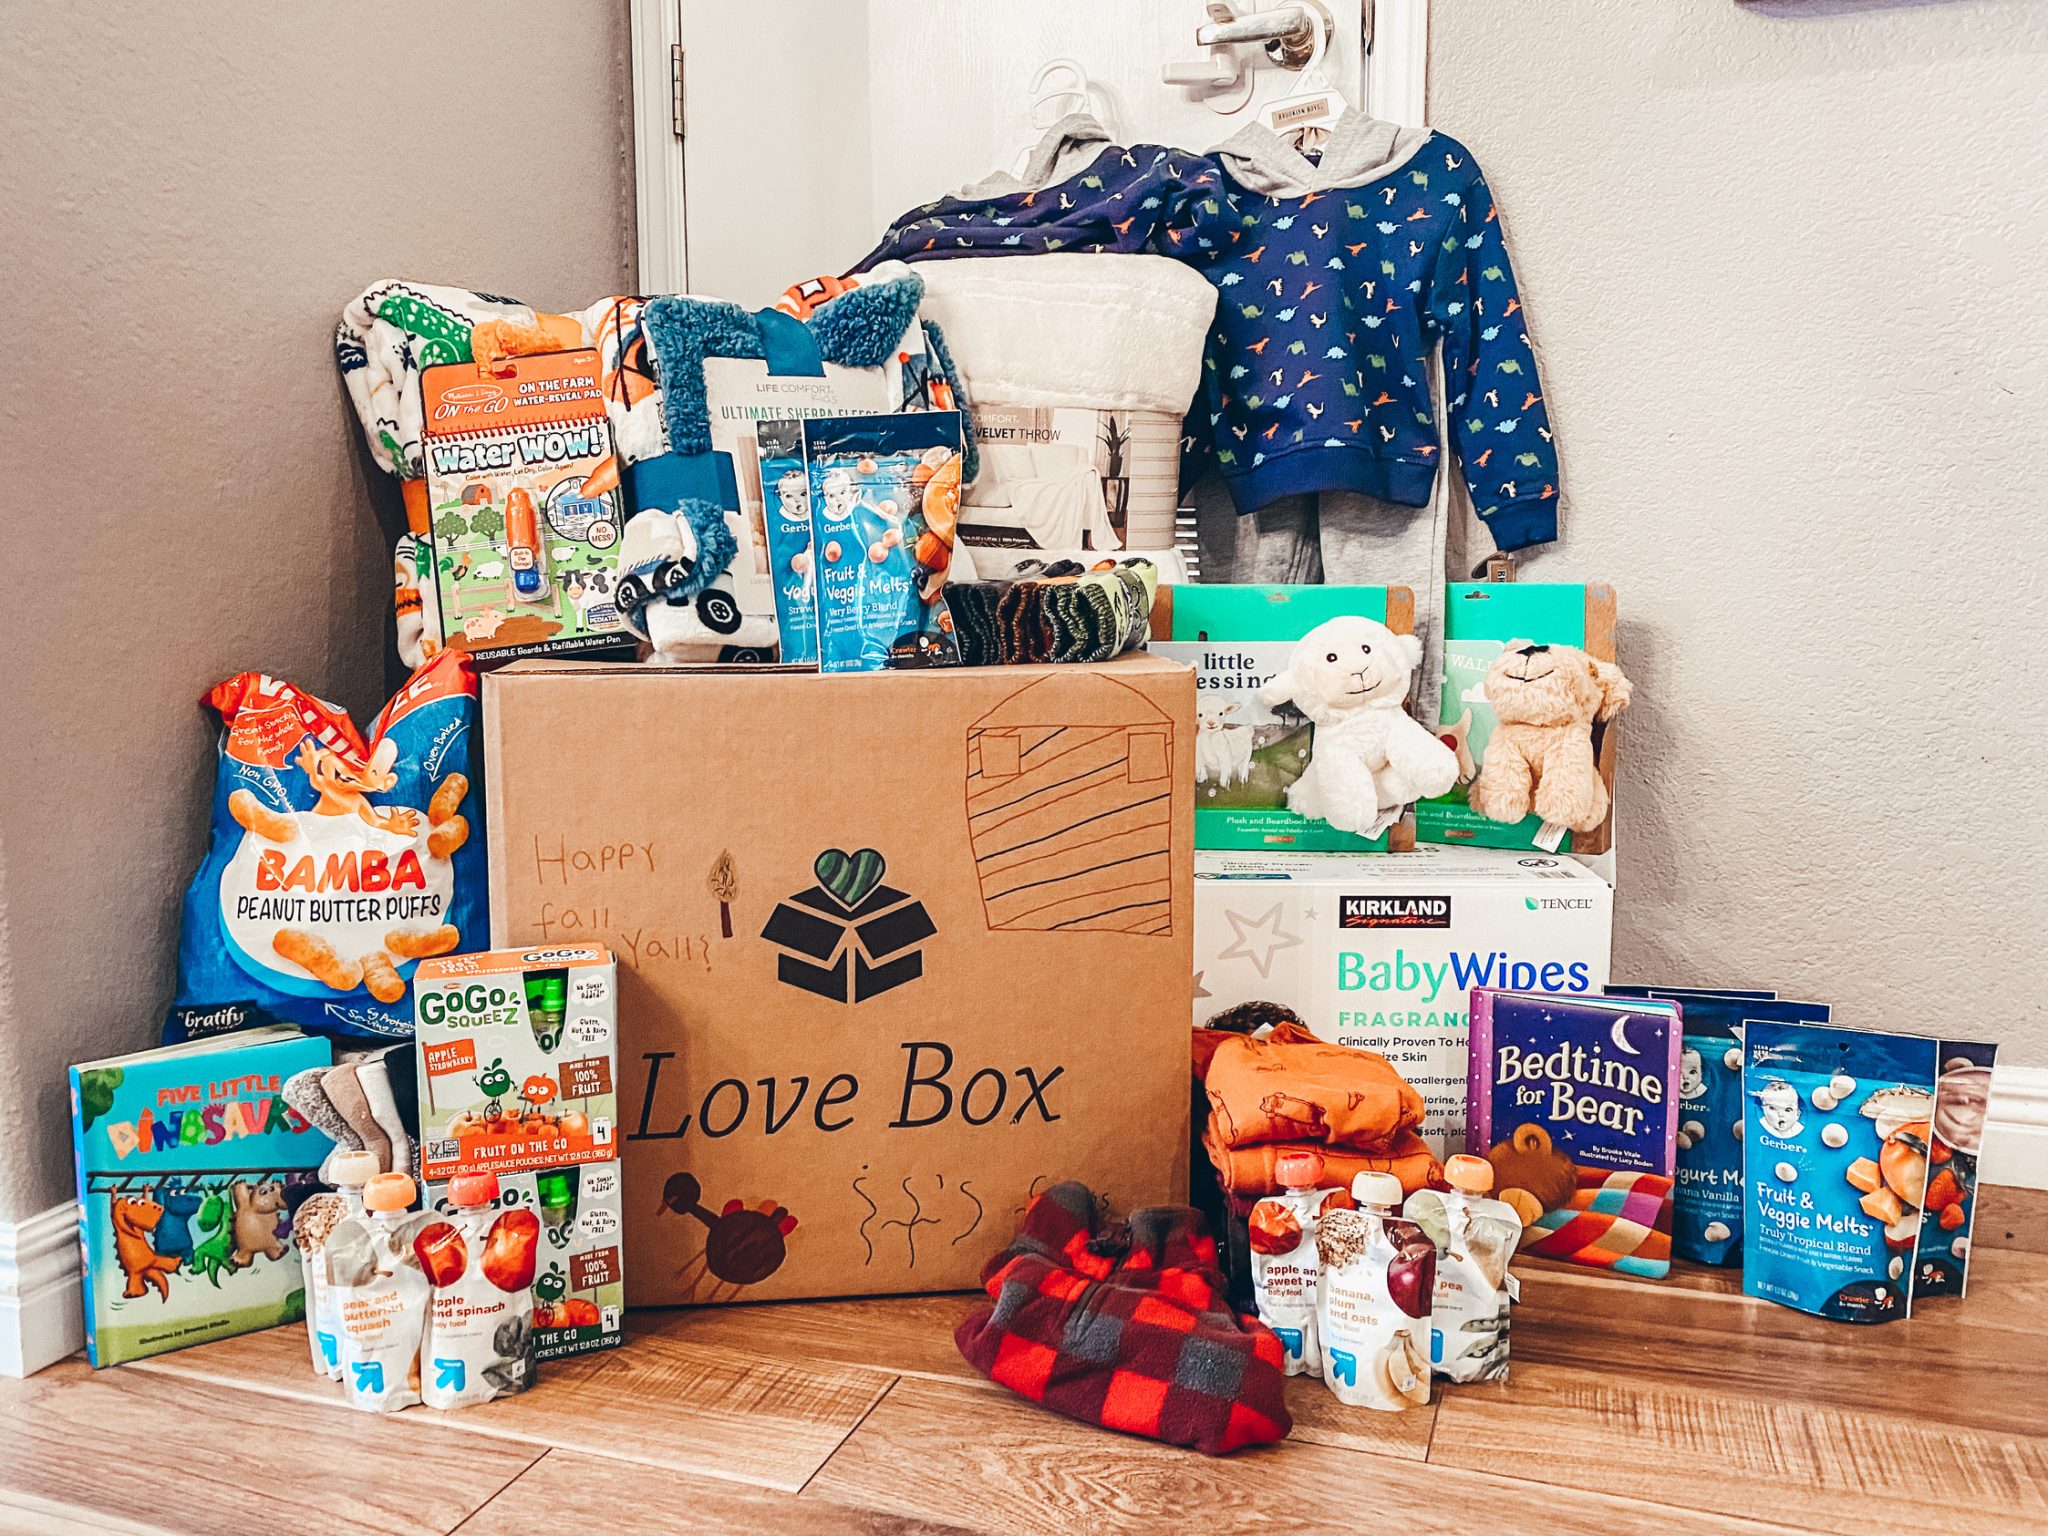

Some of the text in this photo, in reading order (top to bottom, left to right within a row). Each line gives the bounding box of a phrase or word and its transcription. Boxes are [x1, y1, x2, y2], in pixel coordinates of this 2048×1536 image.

[519, 377, 594, 393] ON THE FARM
[756, 384, 779, 393] LIFE
[513, 388, 602, 407] WATER-REVEAL PAD
[434, 397, 509, 420] ON GO
[721, 406, 783, 420] ULTIMATE
[976, 427, 1061, 441] VELVET THROW
[434, 426, 600, 473] Water WOW!
[596, 526, 607, 534] NO
[591, 534, 614, 542] MESS!
[825, 565, 855, 584] Fruit
[827, 584, 866, 604] Veggie
[872, 601, 898, 611] Blend
[475, 635, 621, 661] REUSABLE Boards & Refillable Water Pen
[1204, 653, 1254, 670] little
[231, 726, 264, 737] Great
[238, 722, 295, 746] for the whole
[257, 741, 285, 756] Family
[424, 717, 463, 772] Oven Baked
[239, 765, 288, 797] Non GMO
[1226, 816, 1264, 825] Plush and
[256, 849, 428, 893] BAMBA
[237, 894, 441, 923] PEANUT BUTTER PUFFS
[1346, 900, 1447, 915] KIRKLAND
[532, 903, 609, 939] fall
[1346, 914, 1447, 928] Signature
[586, 982, 603, 991] Sugar
[419, 984, 506, 1025] GoGo
[185, 1006, 245, 1028] Gratify
[447, 1007, 518, 1029] SQUEEZ
[593, 1026, 608, 1036] Dairy
[1338, 1036, 1453, 1048] Clinically Proven To
[428, 1048, 457, 1063] APPLE
[1402, 1053, 1428, 1062] Skin
[430, 1056, 474, 1071] STRAWBERRY
[574, 1069, 598, 1082] 100%
[1496, 1041, 1662, 1104] Bedtime
[157, 1074, 281, 1107] FIVE LITTLE
[571, 1081, 601, 1096] FRUIT
[627, 1041, 1064, 1141] Love Box
[1515, 1081, 1645, 1137] for Bear
[107, 1093, 313, 1160] DINOSAURS
[597, 1126, 605, 1140] 4
[473, 1146, 506, 1159] FRUIT
[510, 1143, 525, 1155] ON
[528, 1141, 549, 1153] THE
[553, 1138, 568, 1150] GO
[1592, 1145, 1641, 1158] By Brooke Vitale
[476, 1159, 515, 1172] APPLESAUCE
[546, 1153, 557, 1164] NET
[558, 1153, 569, 1162] WT
[1579, 1150, 1609, 1160] Illustrated
[1610, 1154, 1618, 1162] by
[1619, 1156, 1633, 1165] Lucy
[597, 1176, 612, 1185] Sugar
[1702, 1189, 1740, 1202] Vanilla
[1757, 1182, 1797, 1206] Fruit
[1800, 1191, 1814, 1210] &
[1758, 1200, 1810, 1231] Veggie
[602, 1219, 616, 1228] Dairy
[1760, 1224, 1786, 1241] Truly
[1787, 1231, 1834, 1249] Tropical
[1838, 1241, 1871, 1256] Blend
[585, 1260, 607, 1273] 100%
[1267, 1265, 1299, 1276] apple
[582, 1271, 610, 1287] FRUIT
[1267, 1277, 1303, 1286] sweet
[1440, 1281, 1463, 1291] pea
[456, 1302, 505, 1318] spinach
[449, 1320, 467, 1328] food
[606, 1315, 613, 1328] 4
[1351, 1315, 1378, 1326] oats
[541, 1329, 577, 1346] THE GO
[568, 1343, 579, 1353] WT
